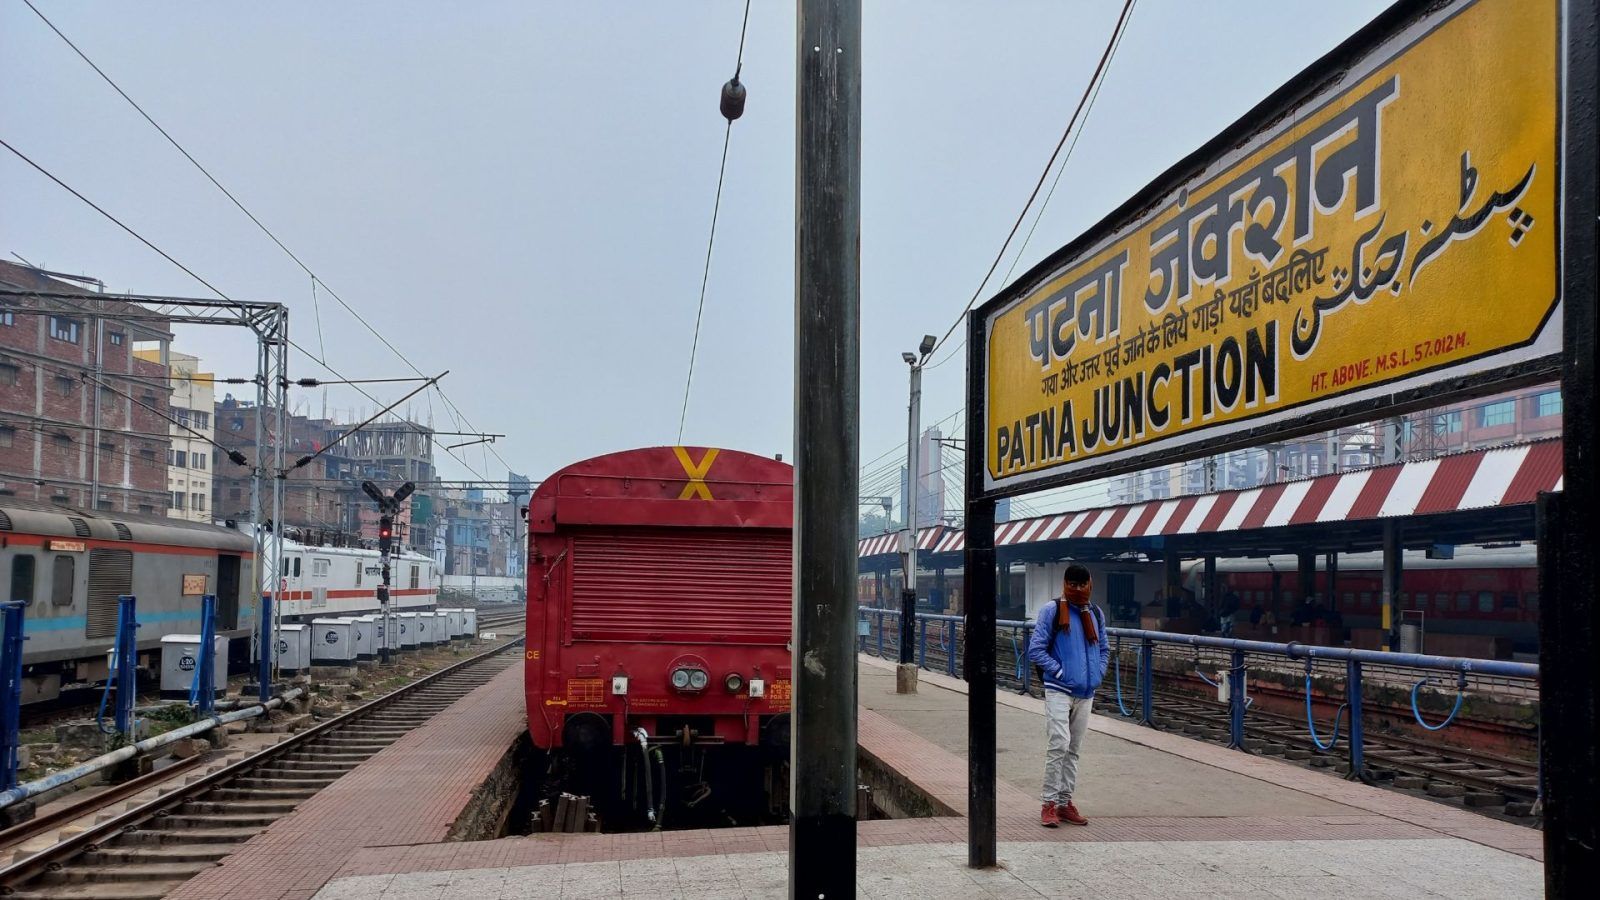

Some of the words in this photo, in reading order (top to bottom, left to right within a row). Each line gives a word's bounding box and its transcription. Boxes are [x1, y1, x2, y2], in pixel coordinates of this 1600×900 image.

[1025, 248, 1130, 372] पटना
[1143, 74, 1400, 315] जंक्शन
[1041, 372, 1058, 397] गया
[1060, 358, 1079, 390] और
[1079, 354, 1101, 382] उत्तर
[1103, 334, 1122, 377] पूर्व
[1122, 325, 1146, 366] जाने
[1146, 320, 1161, 353] के
[1161, 306, 1189, 350] लिये
[1192, 288, 1226, 335] गाड़ी
[1228, 266, 1261, 318] यहाँ
[1262, 246, 1329, 304] बदलिए
[1311, 371, 1328, 393] HT.
[1331, 358, 1373, 387] ABOVE.
[997, 399, 1079, 476] PATNA
[1082, 319, 1280, 453] JUNCTION
[526, 650, 540, 660] CE
